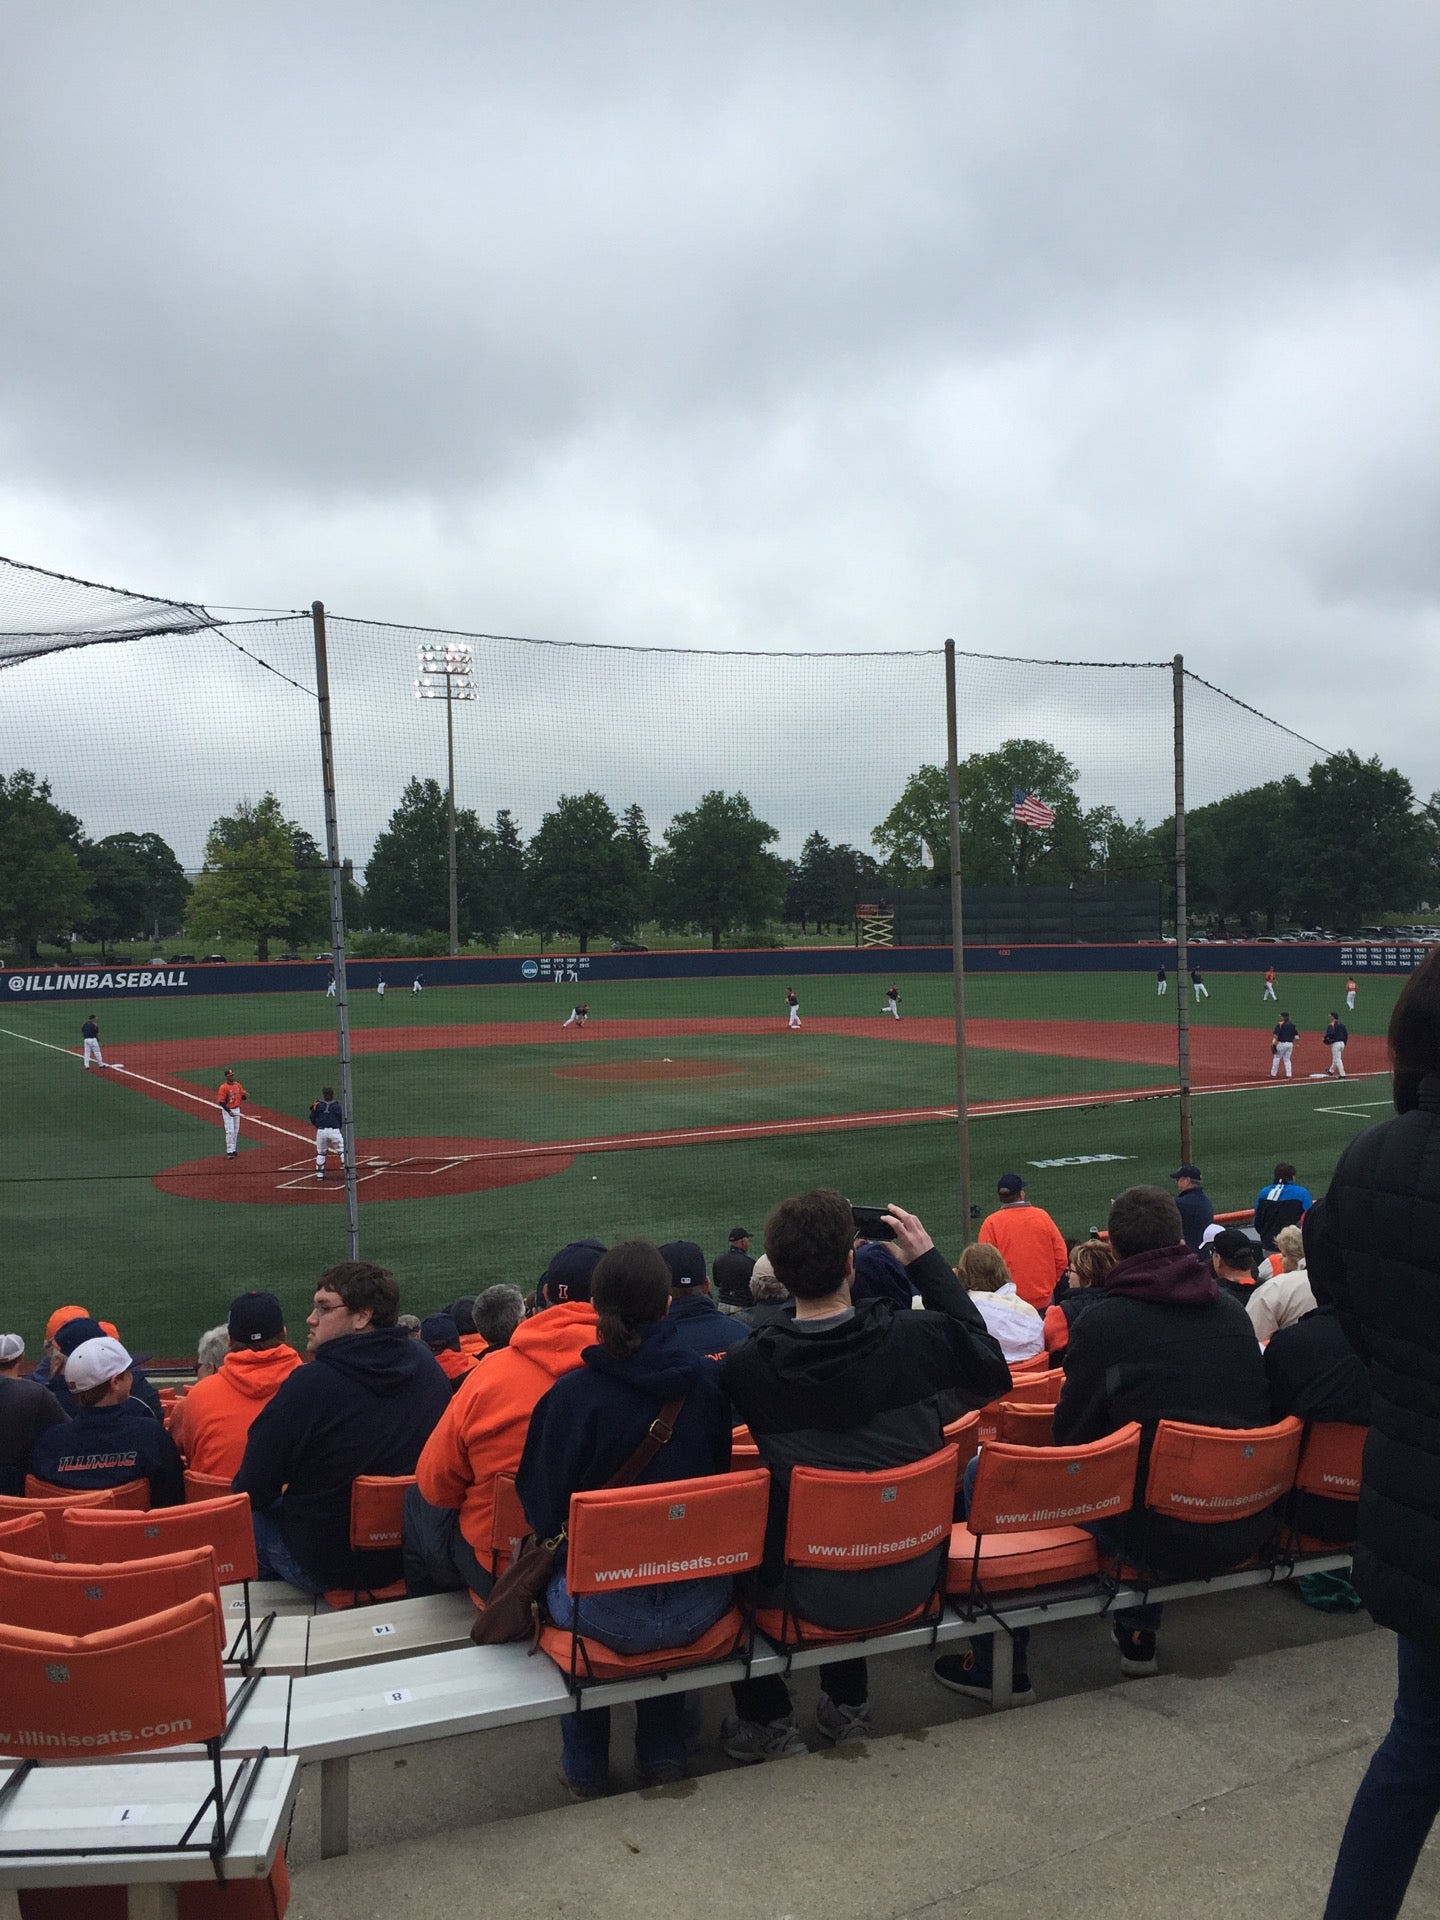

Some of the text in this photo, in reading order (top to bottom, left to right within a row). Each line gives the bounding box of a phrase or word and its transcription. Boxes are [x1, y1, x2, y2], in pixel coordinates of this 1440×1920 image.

[8, 971, 188, 992] @ILLINIBASEBALL
[58, 1451, 137, 1472] ILLINOIS
[995, 1495, 1120, 1524] www.illiniseats.com
[808, 1525, 942, 1557] www.illiniseats.com
[595, 1552, 749, 1582] www.illiniseats.com
[0, 1718, 192, 1747] w.illiniseats.com
